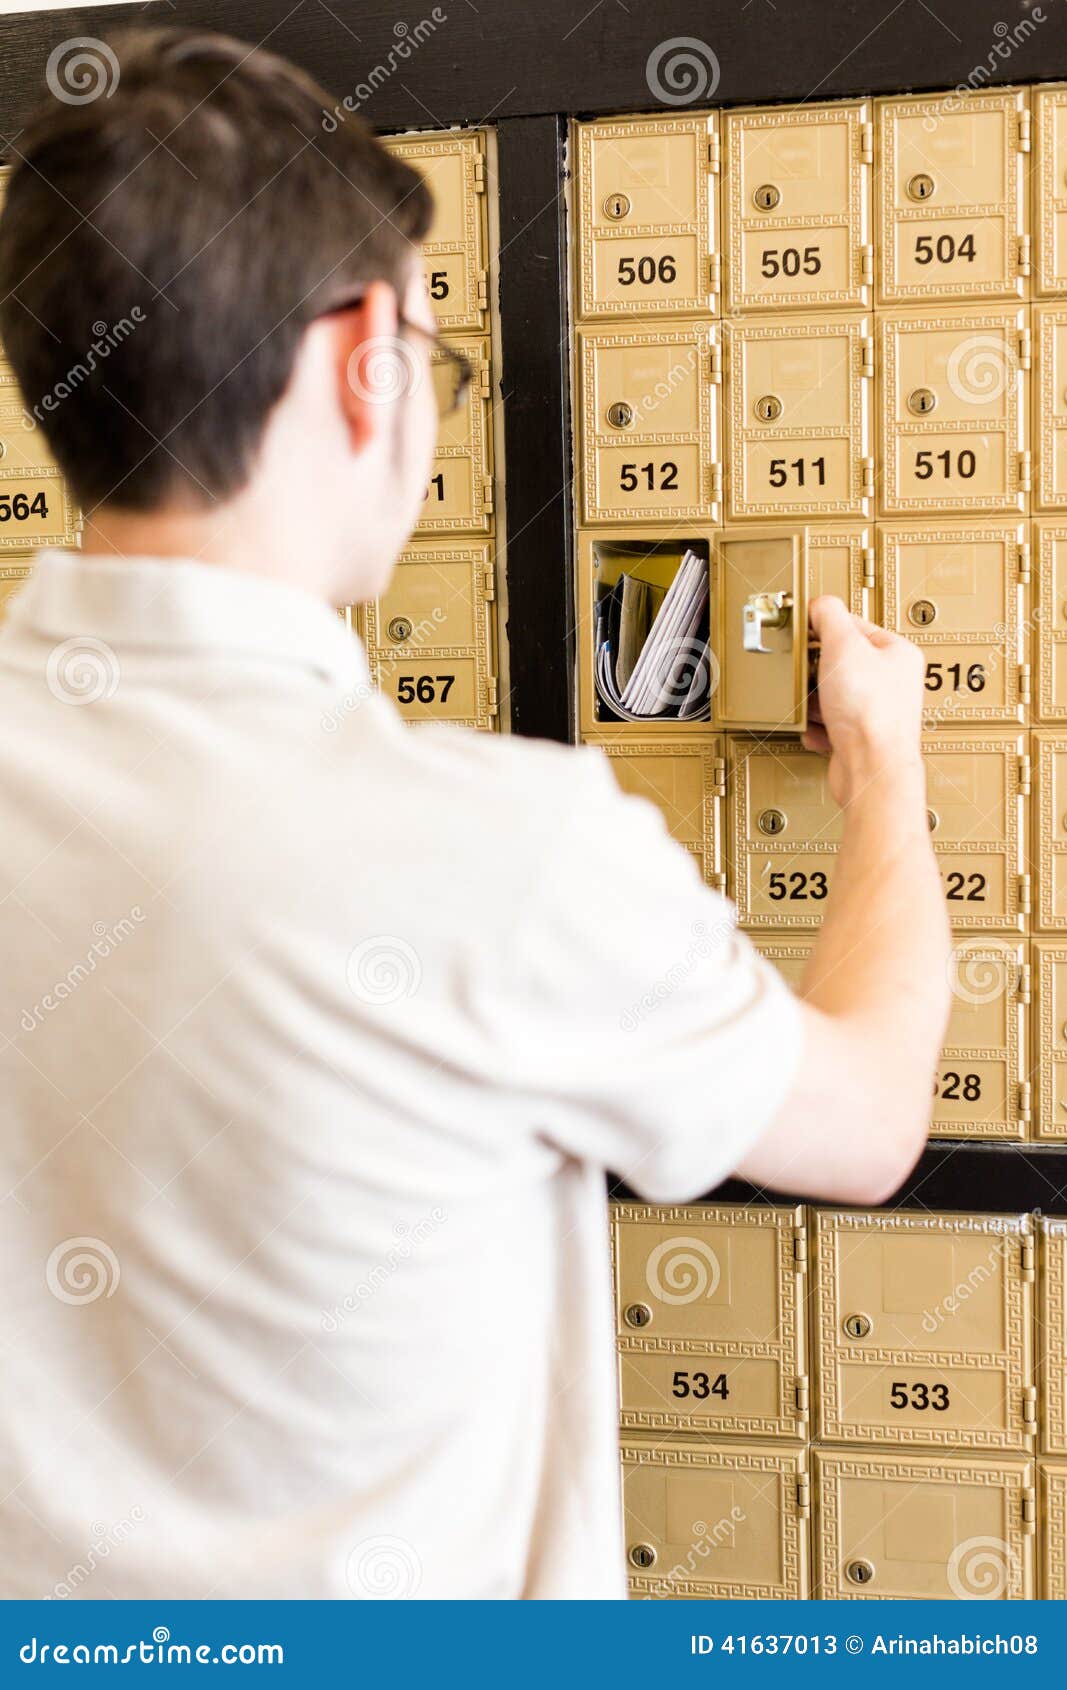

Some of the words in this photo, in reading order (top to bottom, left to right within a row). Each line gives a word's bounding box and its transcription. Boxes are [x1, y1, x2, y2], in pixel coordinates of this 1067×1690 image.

[761, 247, 822, 279] 505
[914, 234, 977, 265] 504
[617, 255, 677, 286] 506
[619, 461, 679, 492] 512
[769, 457, 825, 488] 511
[914, 449, 976, 480] 510
[0, 491, 49, 522] 564
[397, 675, 456, 705] 567
[924, 663, 986, 693] 516
[768, 871, 829, 901] 523
[940, 871, 986, 902] 22
[934, 1071, 981, 1102] 28
[672, 1371, 730, 1401] 534
[890, 1382, 950, 1412] 533
